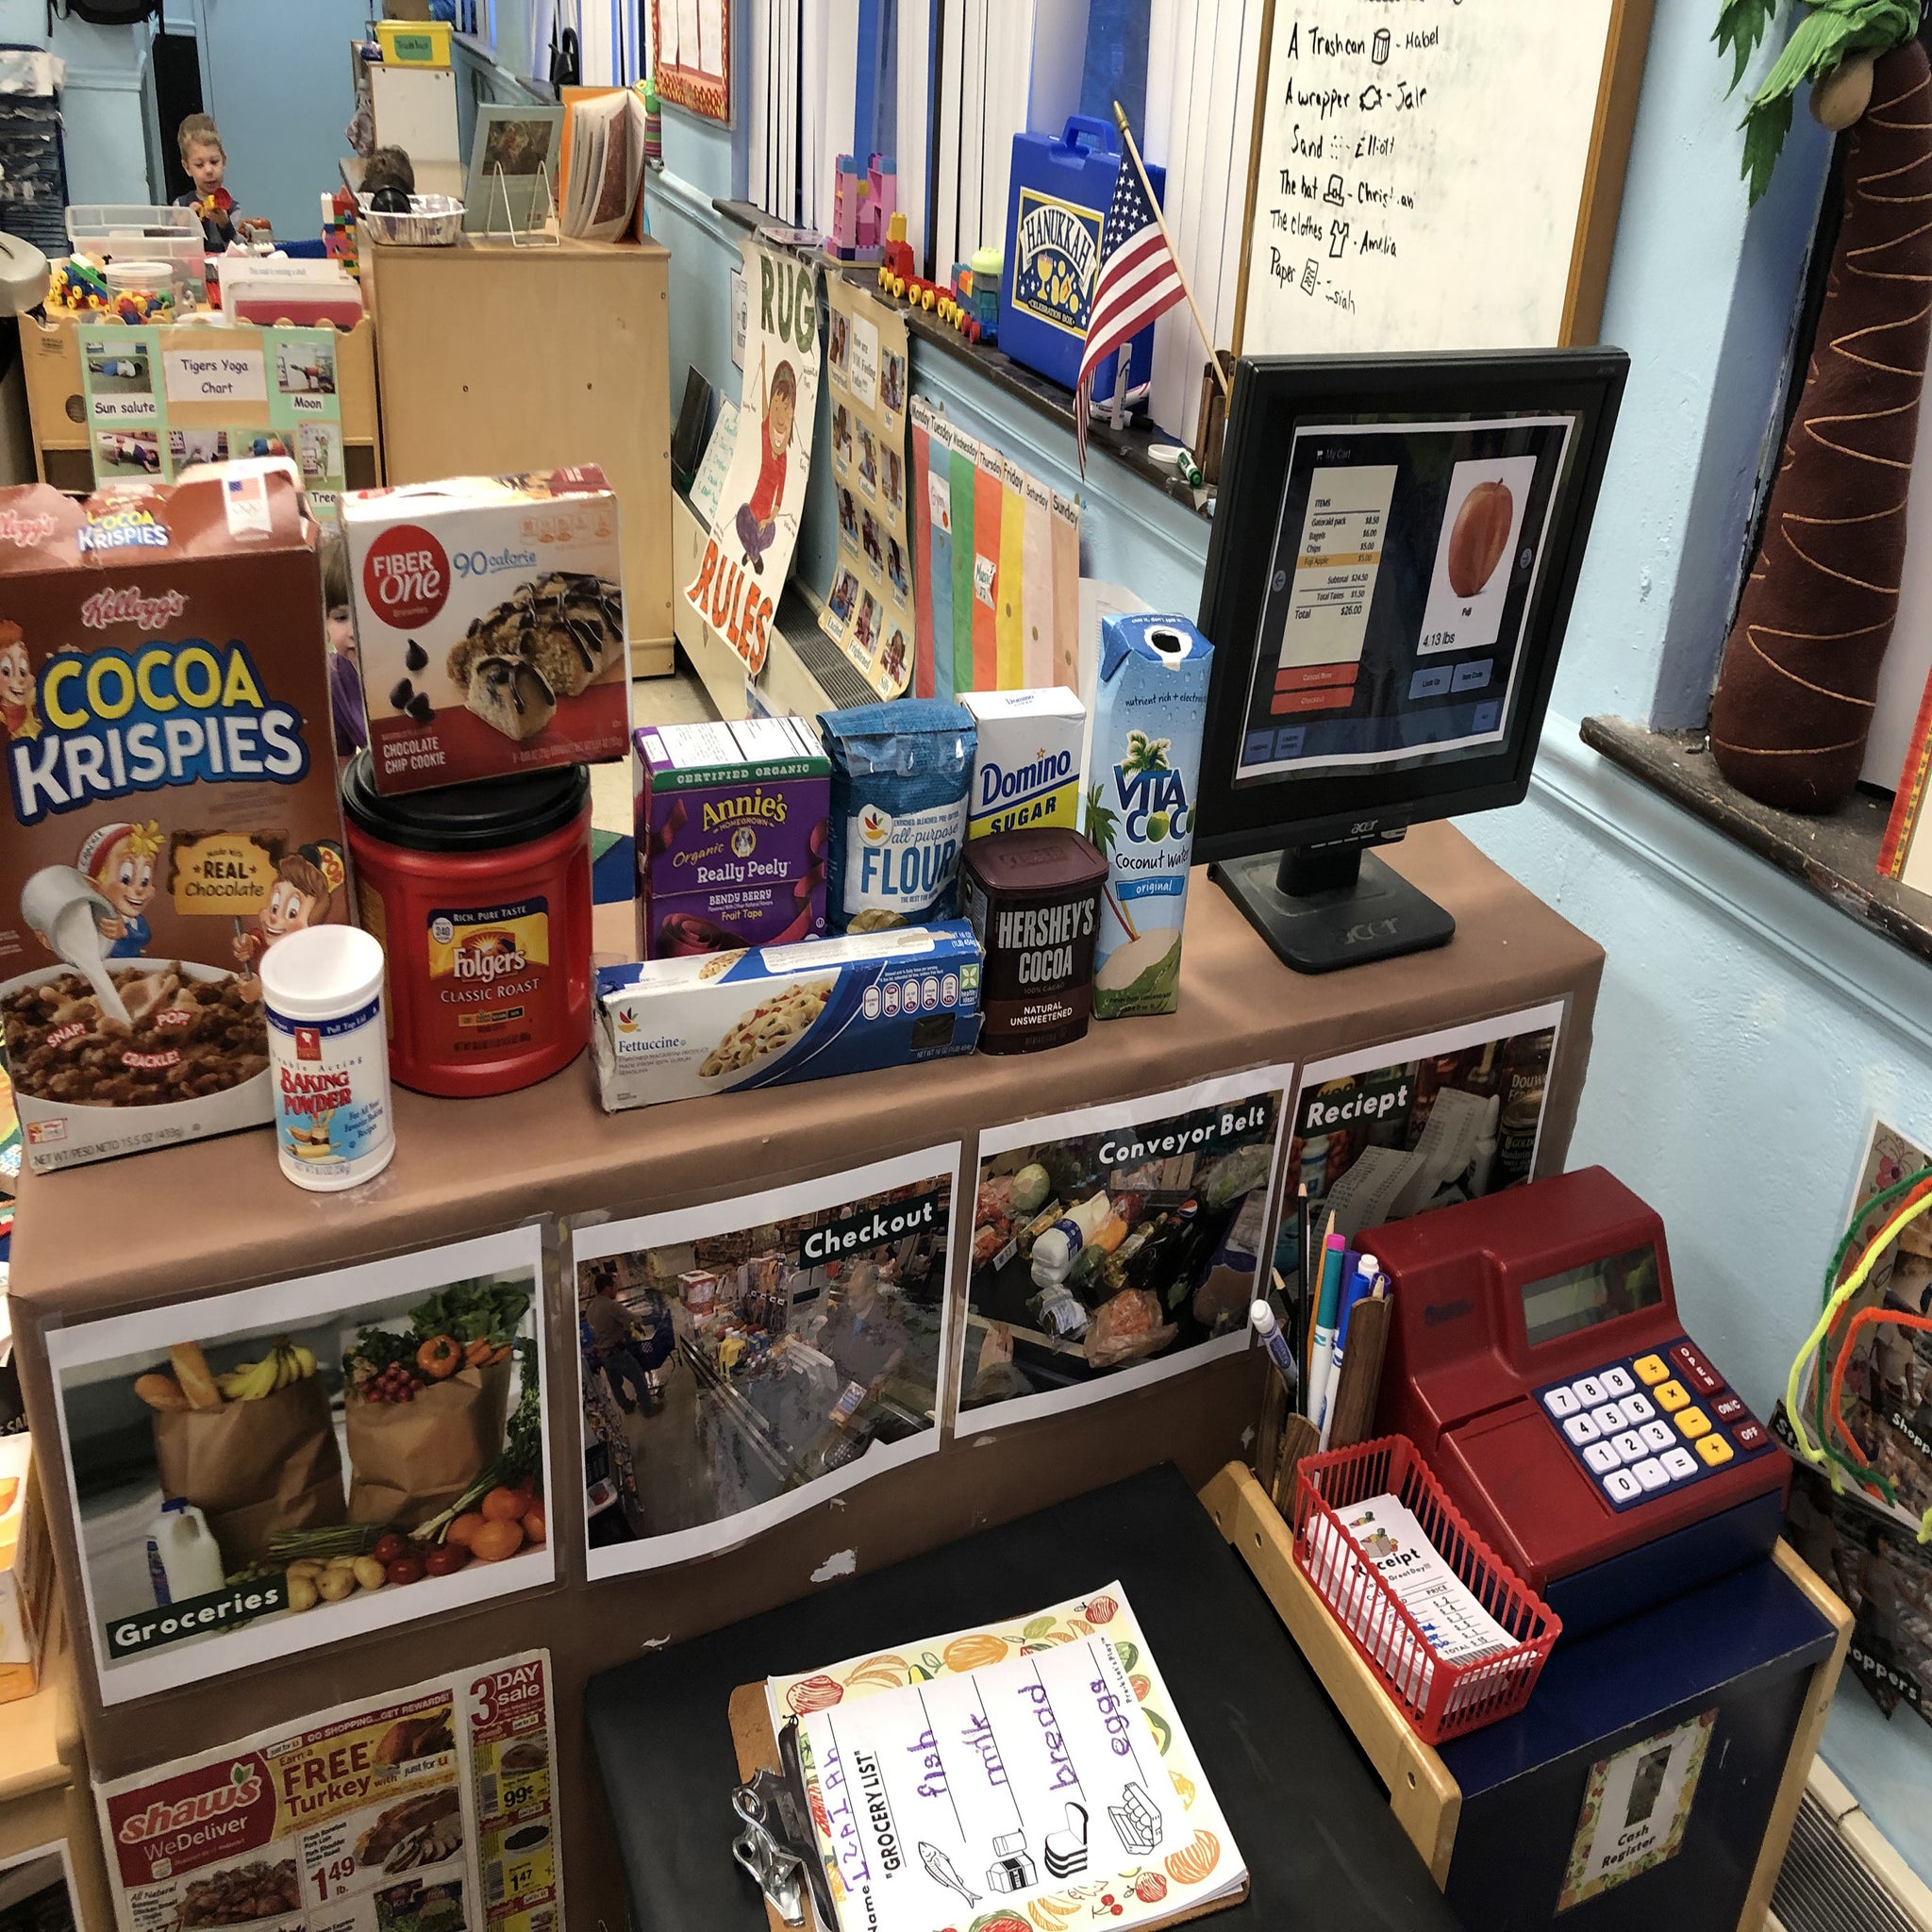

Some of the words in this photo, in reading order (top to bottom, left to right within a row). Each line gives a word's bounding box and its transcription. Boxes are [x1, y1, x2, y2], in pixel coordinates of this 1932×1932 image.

[1288, 22, 1298, 59] A
[1286, 76, 1293, 105] A
[1298, 89, 1350, 120] wrapper
[1291, 124, 1323, 158] Sand
[1280, 169, 1296, 195] The
[1301, 175, 1318, 200] hat
[1025, 209, 1091, 274] HANUKKAH
[1271, 209, 1287, 231] The
[1291, 212, 1322, 242] clothes
[1360, 230, 1396, 258] Amelia
[1271, 246, 1295, 289] Paper
[760, 255, 815, 354] RUG
[1030, 300, 1061, 321] CELEBRATION
[1062, 313, 1074, 325] BOX
[181, 358, 217, 374] Tigers
[222, 358, 248, 374] Yoga
[201, 382, 233, 394] Chart
[95, 402, 116, 414] Sun
[121, 401, 156, 414] salute
[294, 396, 322, 409] Moon
[912, 405, 929, 428] Monday
[931, 415, 952, 446] Tuesday
[953, 432, 978, 461] Wednesday
[980, 452, 1002, 478] Thursday
[1004, 462, 1024, 493] Friday
[1026, 484, 1048, 510] Saturday
[1054, 495, 1078, 530] Sunday
[311, 491, 336, 504] Tree
[1315, 499, 1331, 508] ITEMS
[78, 525, 169, 552] KRISPIES
[1307, 544, 1321, 554] Chips
[1360, 542, 1374, 551] $5.00
[1309, 531, 1325, 541] Bagels
[374, 550, 433, 577] FIBER
[454, 551, 488, 578] 90
[490, 549, 537, 567] calorie
[1315, 557, 1329, 566] Apple
[1358, 554, 1372, 562] $5.00
[1327, 575, 1349, 584] Subtotal
[1352, 574, 1368, 582] $24.50
[82, 587, 189, 630] Kellogg's
[688, 539, 773, 673] RULES
[1317, 592, 1330, 601] Total
[1330, 591, 1344, 600] Taxes
[1351, 590, 1365, 598] $1.50
[1295, 609, 1311, 620] Total
[1341, 606, 1362, 615] $26.00
[828, 617, 843, 639] Excited
[1423, 633, 1441, 647] 4.13
[1442, 632, 1455, 644] lbs
[849, 639, 871, 670] Frightened
[43, 647, 264, 729] COCOA
[1125, 694, 1156, 707] nutrient
[1158, 692, 1171, 703] rich
[1301, 696, 1325, 705] Checkout
[383, 737, 439, 758] CHOCOLATE
[14, 709, 303, 816] KRISPIES
[385, 759, 407, 774] CHIP
[411, 753, 445, 770] COOKIE
[676, 769, 749, 784] CERTIFIED
[756, 764, 809, 777] ORGANIC
[980, 750, 1071, 807] Domino
[1113, 765, 1187, 812] VITA
[703, 788, 788, 831] Annie's
[991, 796, 1057, 834] SUGAR
[720, 817, 769, 830] HOMEGROWN
[891, 824, 958, 845] all-purpose
[1351, 820, 1378, 834] acer
[322, 850, 342, 884] POP
[673, 842, 724, 868] Organic
[861, 840, 958, 894] FLOUR
[1115, 849, 1165, 869] Coconut
[1168, 845, 1190, 868] Water
[204, 860, 249, 879] REAL
[697, 864, 744, 884] Really
[747, 858, 789, 877] Peely
[186, 882, 264, 897] Chocolate
[709, 892, 740, 907] BENDY
[742, 890, 772, 902] BERRY
[1137, 879, 1173, 894] original
[478, 910, 499, 922] PURE
[502, 906, 527, 919] TASTE
[722, 910, 741, 922] Fruit
[743, 908, 763, 921] Tape
[998, 897, 1095, 949] HERSHEY'S
[453, 947, 525, 983] Folgers
[1019, 945, 1073, 984] COCOA
[441, 988, 492, 1004] CLASSIC
[497, 978, 541, 998] ROAST
[1010, 1008, 1073, 1026] UNSWEETENED
[1024, 1001, 1062, 1015] NATURAL
[47, 1023, 86, 1048] SNAP!
[618, 1036, 679, 1053] Fettuccine
[122, 1050, 180, 1067] CRACKLE!
[320, 1057, 363, 1072] Acting
[281, 1066, 350, 1093] BAKING
[284, 1088, 352, 1115] POWDER
[1307, 1085, 1408, 1128] Reciept
[1099, 1123, 1216, 1164] Conveyor
[1220, 1107, 1265, 1136] Belt
[805, 1202, 933, 1258] Checkout
[1680, 1347, 1715, 1387] OPEN
[1557, 1395, 1567, 1407] 7
[1586, 1384, 1595, 1396] 8
[1612, 1375, 1623, 1387] 9
[1579, 1423, 1589, 1434] 4
[1607, 1412, 1617, 1424] 5
[1633, 1401, 1644, 1413] 6
[1599, 1449, 1608, 1461] 1
[1625, 1439, 1637, 1451] 2
[1653, 1428, 1663, 1440] 3
[1741, 1426, 1758, 1441] OFF
[1892, 1412, 1932, 1458] Shopp
[1619, 1477, 1629, 1491] 0
[1351, 1548, 1421, 1577] Rceipt
[1389, 1570, 1410, 1582] Great
[1426, 1585, 1448, 1595] PRICE
[115, 1589, 278, 1646] Groceries
[1442, 1645, 1468, 1656] TOTAL
[1853, 1648, 1917, 1700] oppers
[470, 1675, 499, 1726] 3
[497, 1663, 539, 1690] DAY
[498, 1684, 541, 1706] sale
[308, 1732, 323, 1742] GO
[402, 1693, 450, 1714] REWARDS!
[1090, 1678, 1130, 1756] eggs
[961, 1713, 1008, 1786] milk
[1018, 1685, 1079, 1790] bread
[279, 1753, 307, 1767] Earn
[405, 1765, 421, 1777] just
[423, 1760, 435, 1771] for
[854, 1750, 879, 1789] LIST"
[908, 1730, 947, 1797] fish
[284, 1775, 371, 1818] Turkey
[375, 1775, 397, 1788] with
[865, 1791, 901, 1879] "GROCERY
[1618, 1824, 1649, 1846] Cash
[1601, 1836, 1656, 1868] Register
